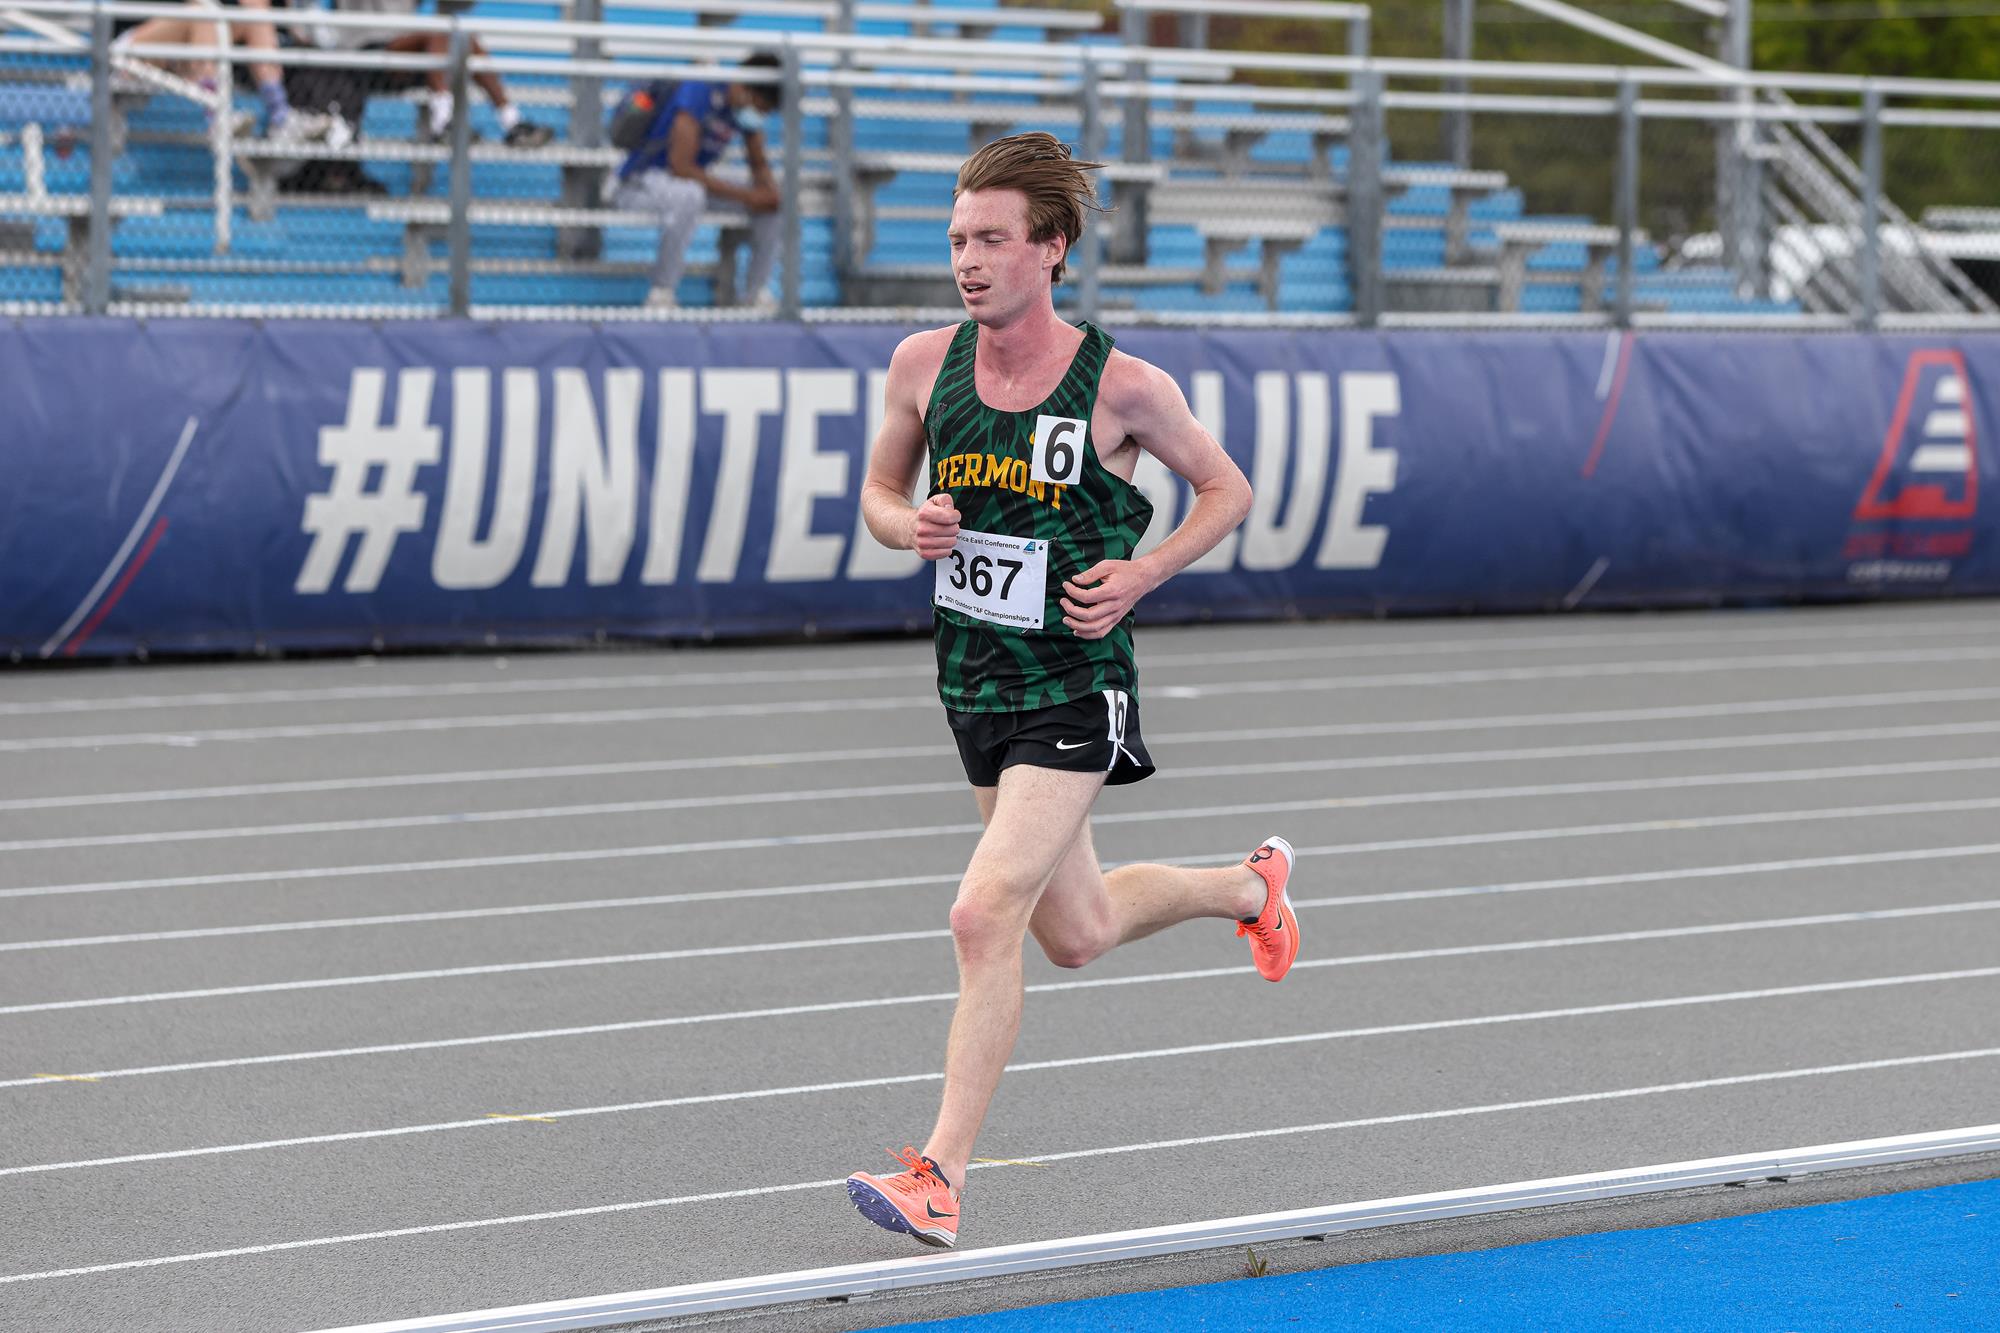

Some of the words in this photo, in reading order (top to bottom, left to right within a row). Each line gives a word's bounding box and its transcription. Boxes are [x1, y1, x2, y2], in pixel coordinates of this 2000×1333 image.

[1045, 421, 1077, 481] 6
[970, 536, 984, 545] East
[984, 539, 1020, 550] Conference
[949, 549, 1023, 601] 367
[944, 595, 955, 604] 2021
[954, 599, 973, 610] Outdoor
[973, 605, 984, 614] T&F
[983, 609, 1030, 622] Championships
